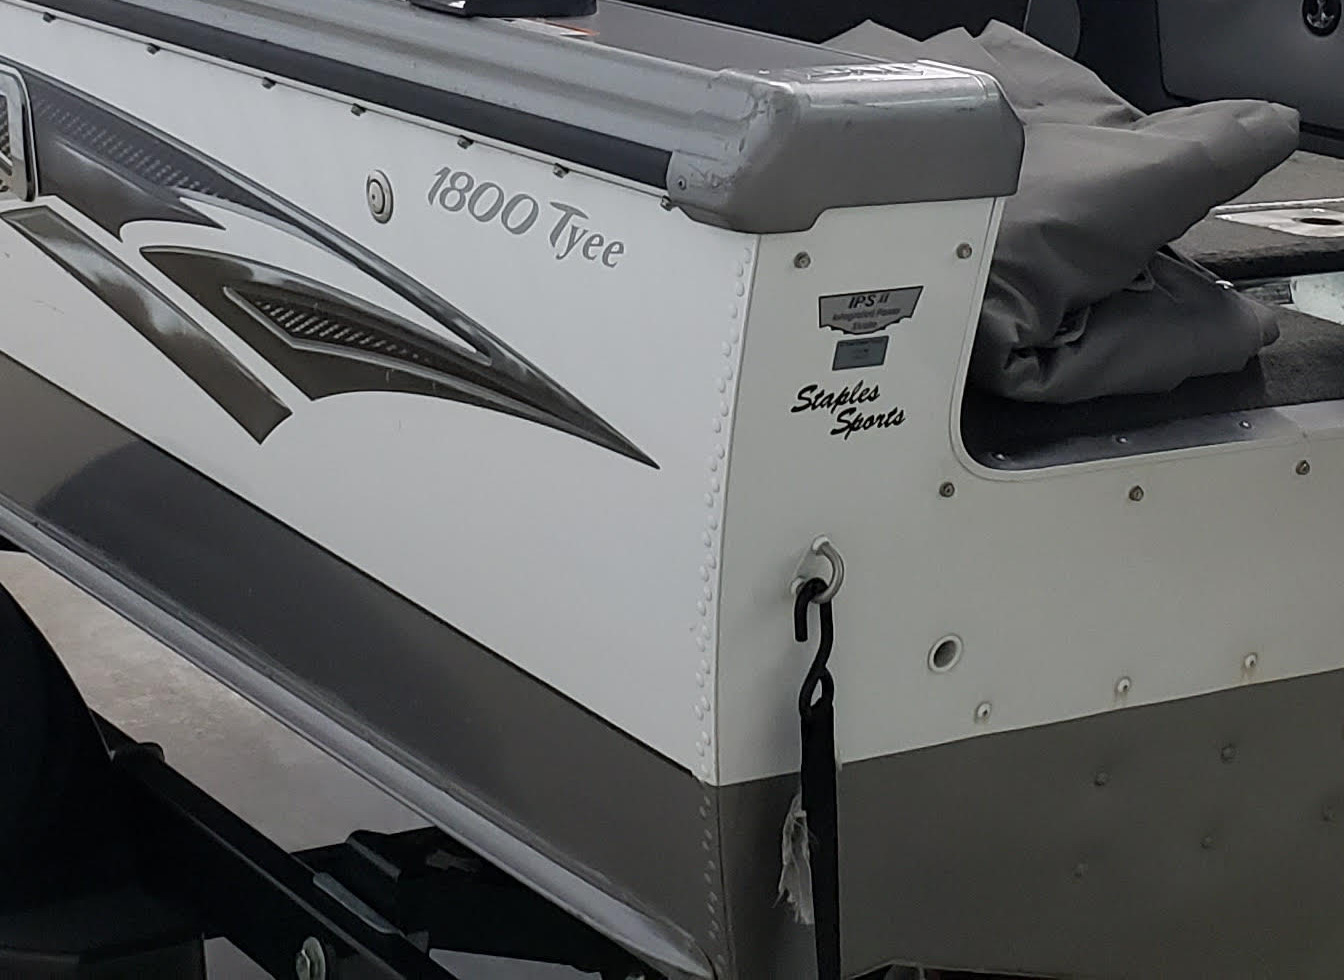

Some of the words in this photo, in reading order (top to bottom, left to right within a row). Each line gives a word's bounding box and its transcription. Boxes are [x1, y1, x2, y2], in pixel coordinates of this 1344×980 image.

[427, 166, 539, 235] 1800
[549, 201, 625, 268] Tyee
[848, 294, 876, 309] IPS
[791, 380, 881, 414] Staples
[830, 406, 906, 440] Sports
